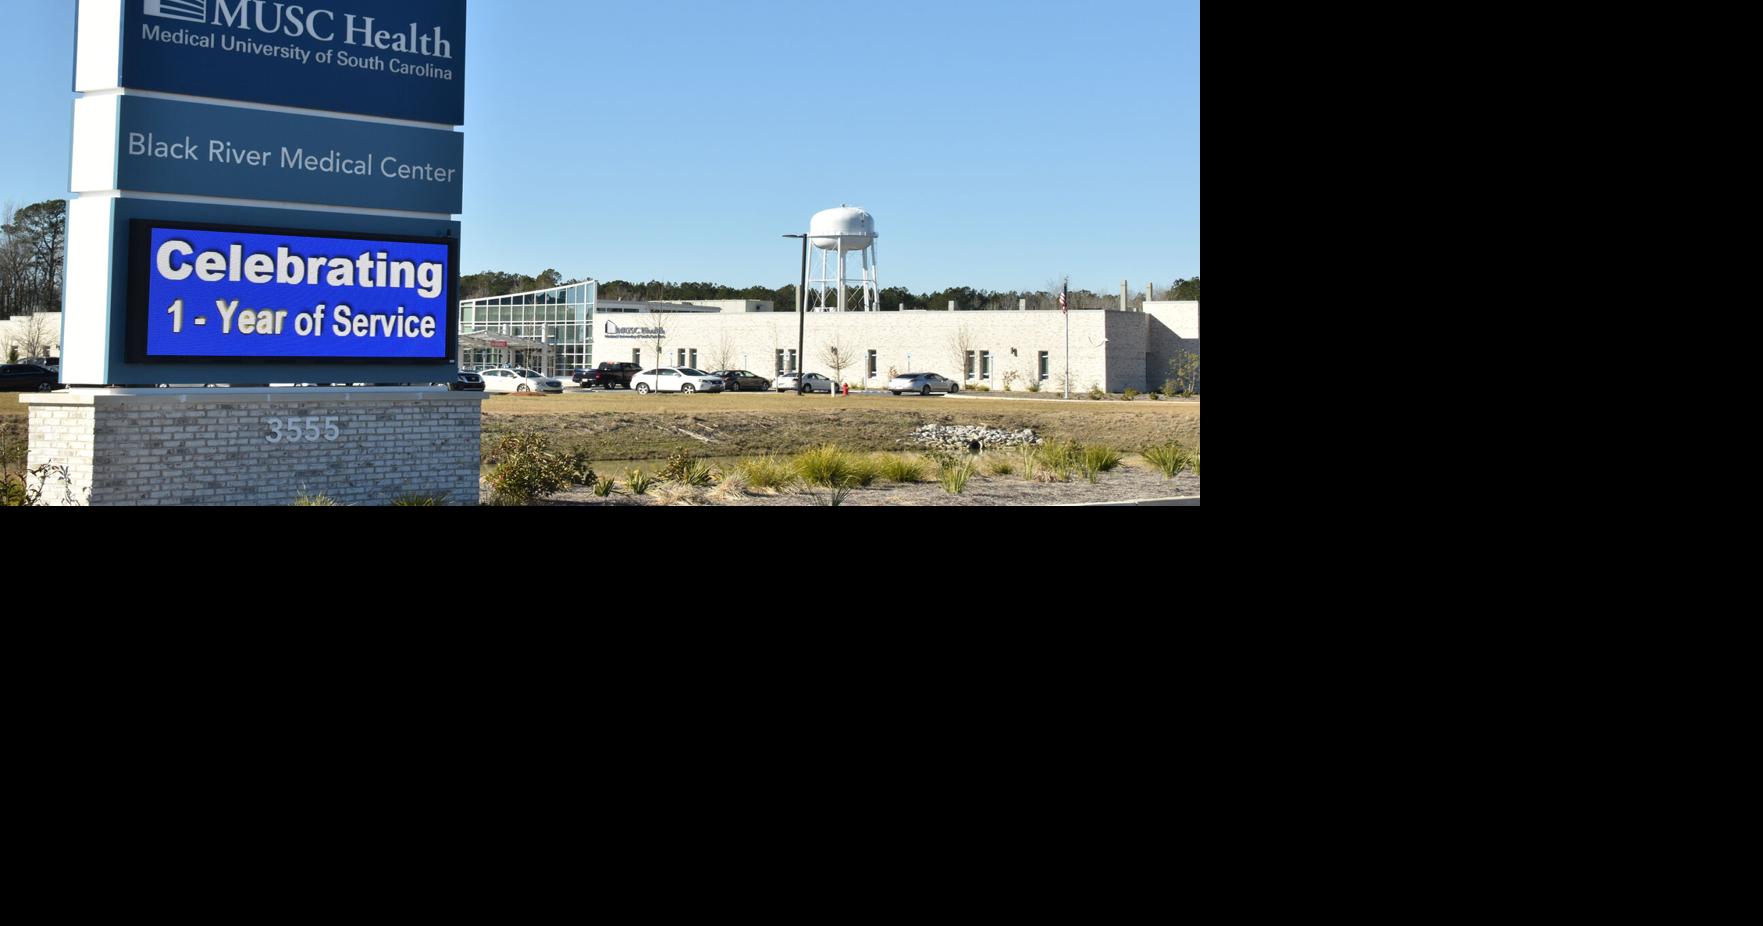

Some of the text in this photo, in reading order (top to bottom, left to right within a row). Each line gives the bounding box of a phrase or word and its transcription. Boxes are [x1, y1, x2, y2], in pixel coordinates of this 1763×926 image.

[142, 23, 452, 80] Medical University of South Carolina
[211, 0, 452, 59] MUSC Health
[128, 132, 456, 182] Black River Medical Center
[156, 239, 444, 299] Celebrating
[167, 299, 183, 333] 1
[215, 299, 288, 335] Year
[294, 304, 326, 337] of
[332, 304, 436, 338] Service
[265, 415, 340, 443] 3555
